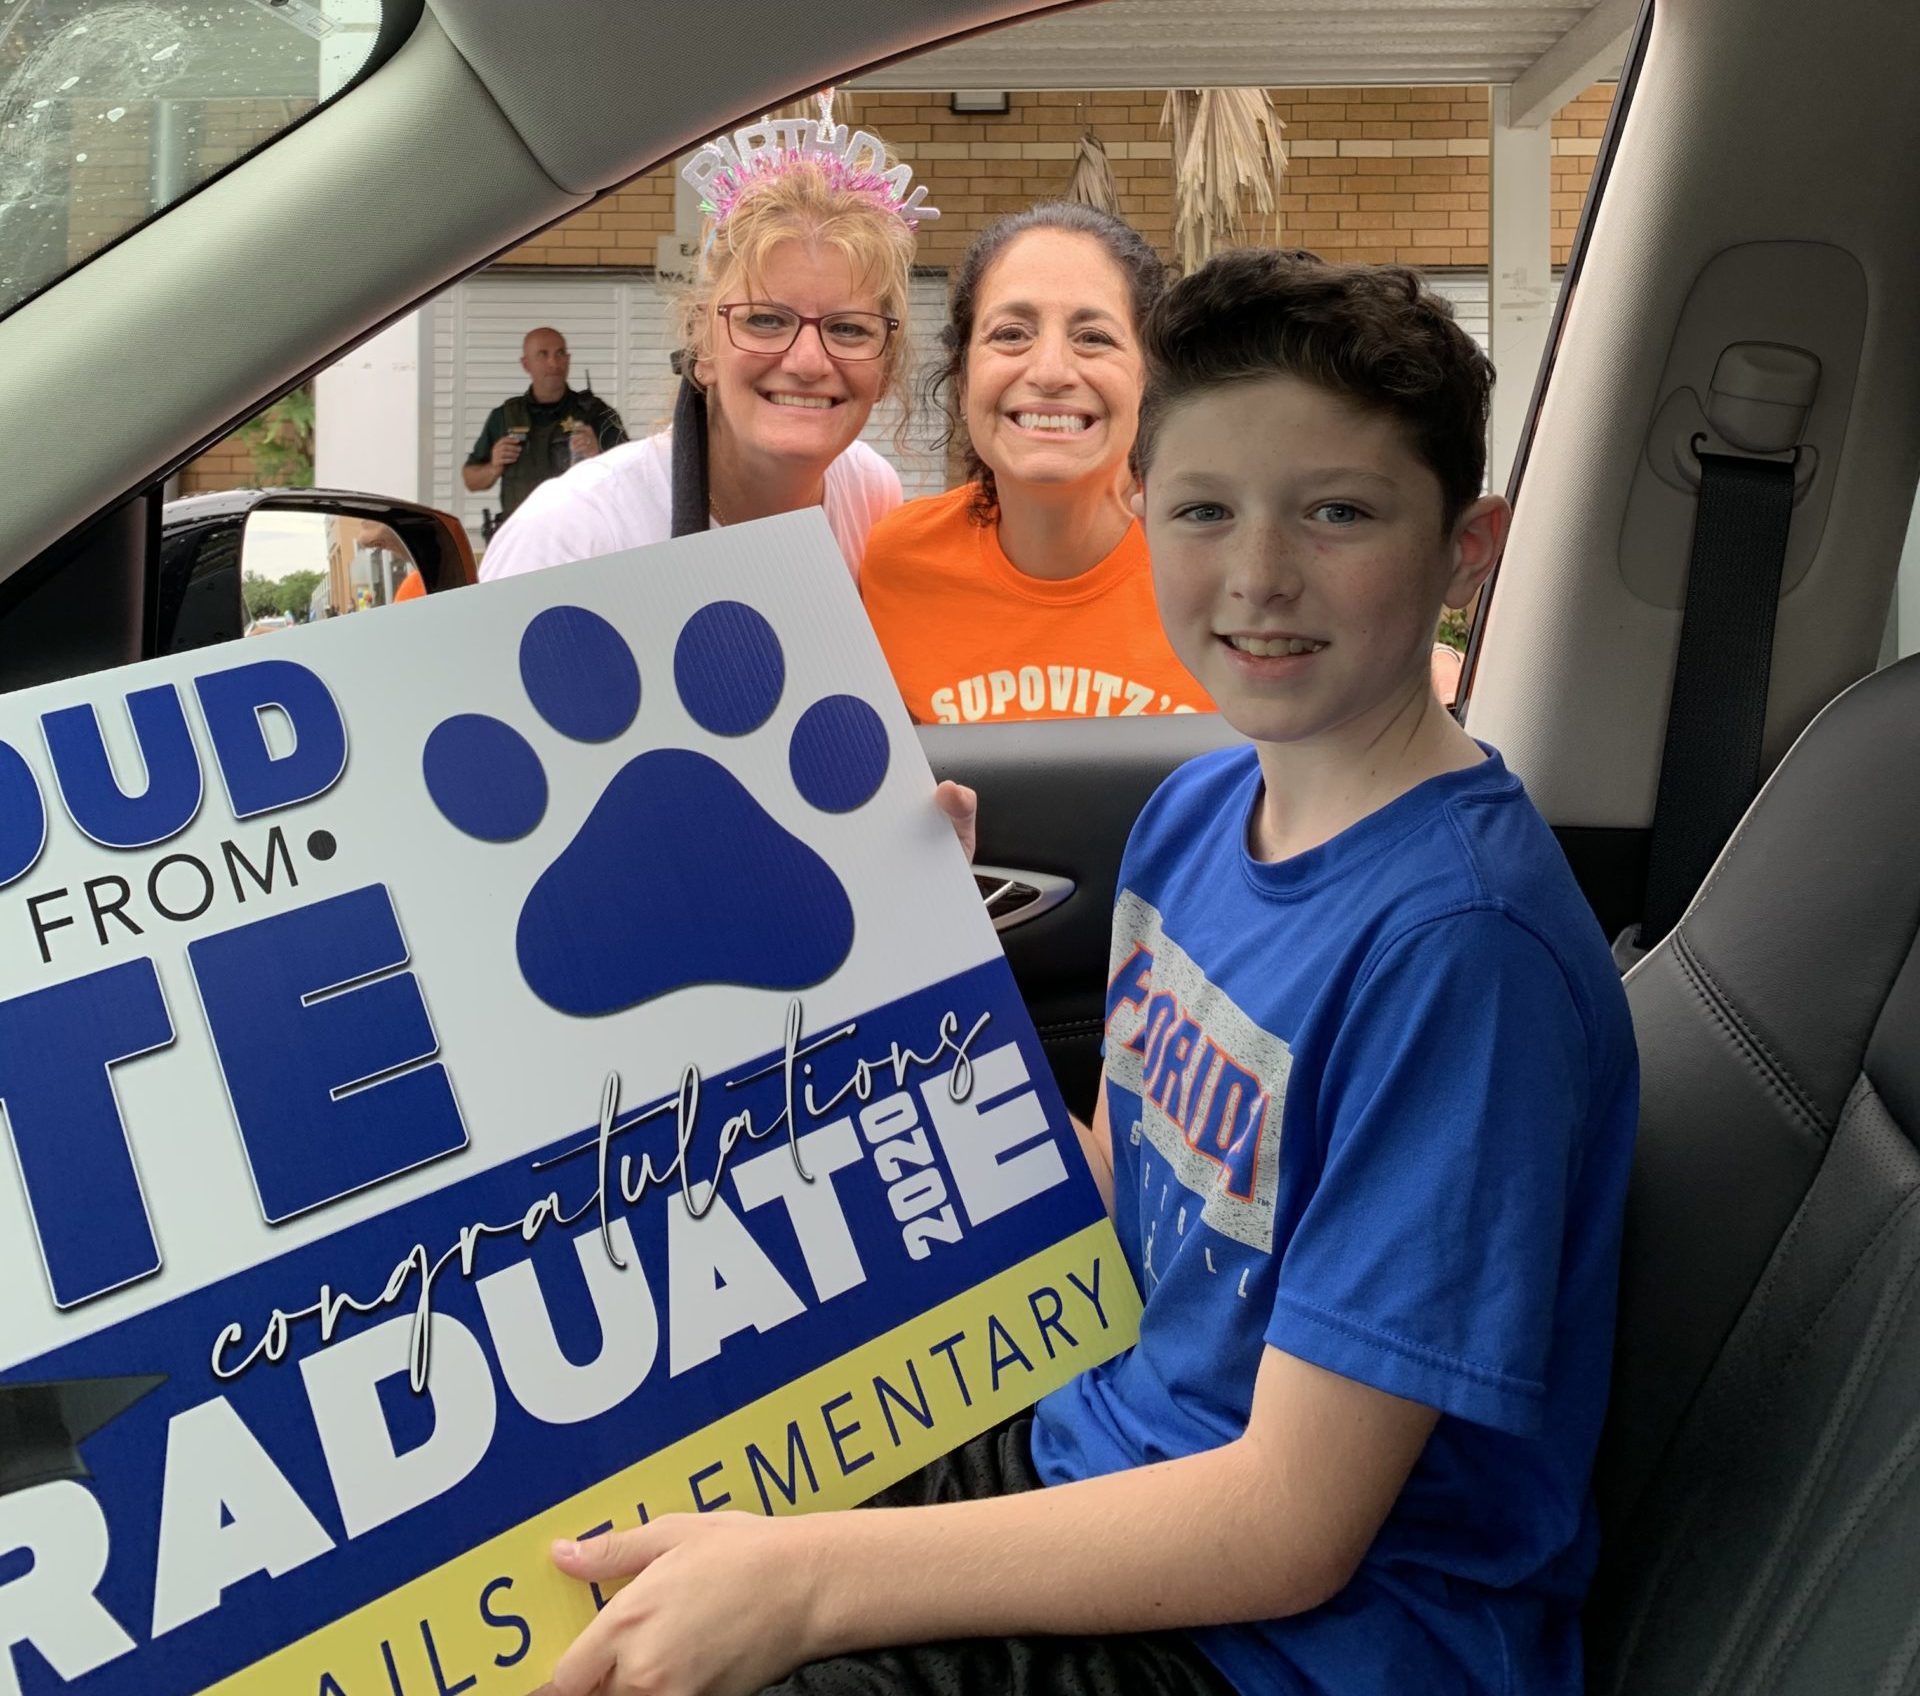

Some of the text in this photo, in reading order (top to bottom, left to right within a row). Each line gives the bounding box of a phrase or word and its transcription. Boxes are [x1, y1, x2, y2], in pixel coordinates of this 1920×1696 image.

[681, 118, 941, 220] BIRTHDAY
[931, 665, 1198, 725] SUPOVITZ'
[26, 825, 300, 964] FROM
[1105, 940, 1269, 1204] FORIDA
[210, 998, 990, 1393] congratulations
[858, 1090, 964, 1262] 2020
[577, 1258, 1110, 1612] EMENTARY
